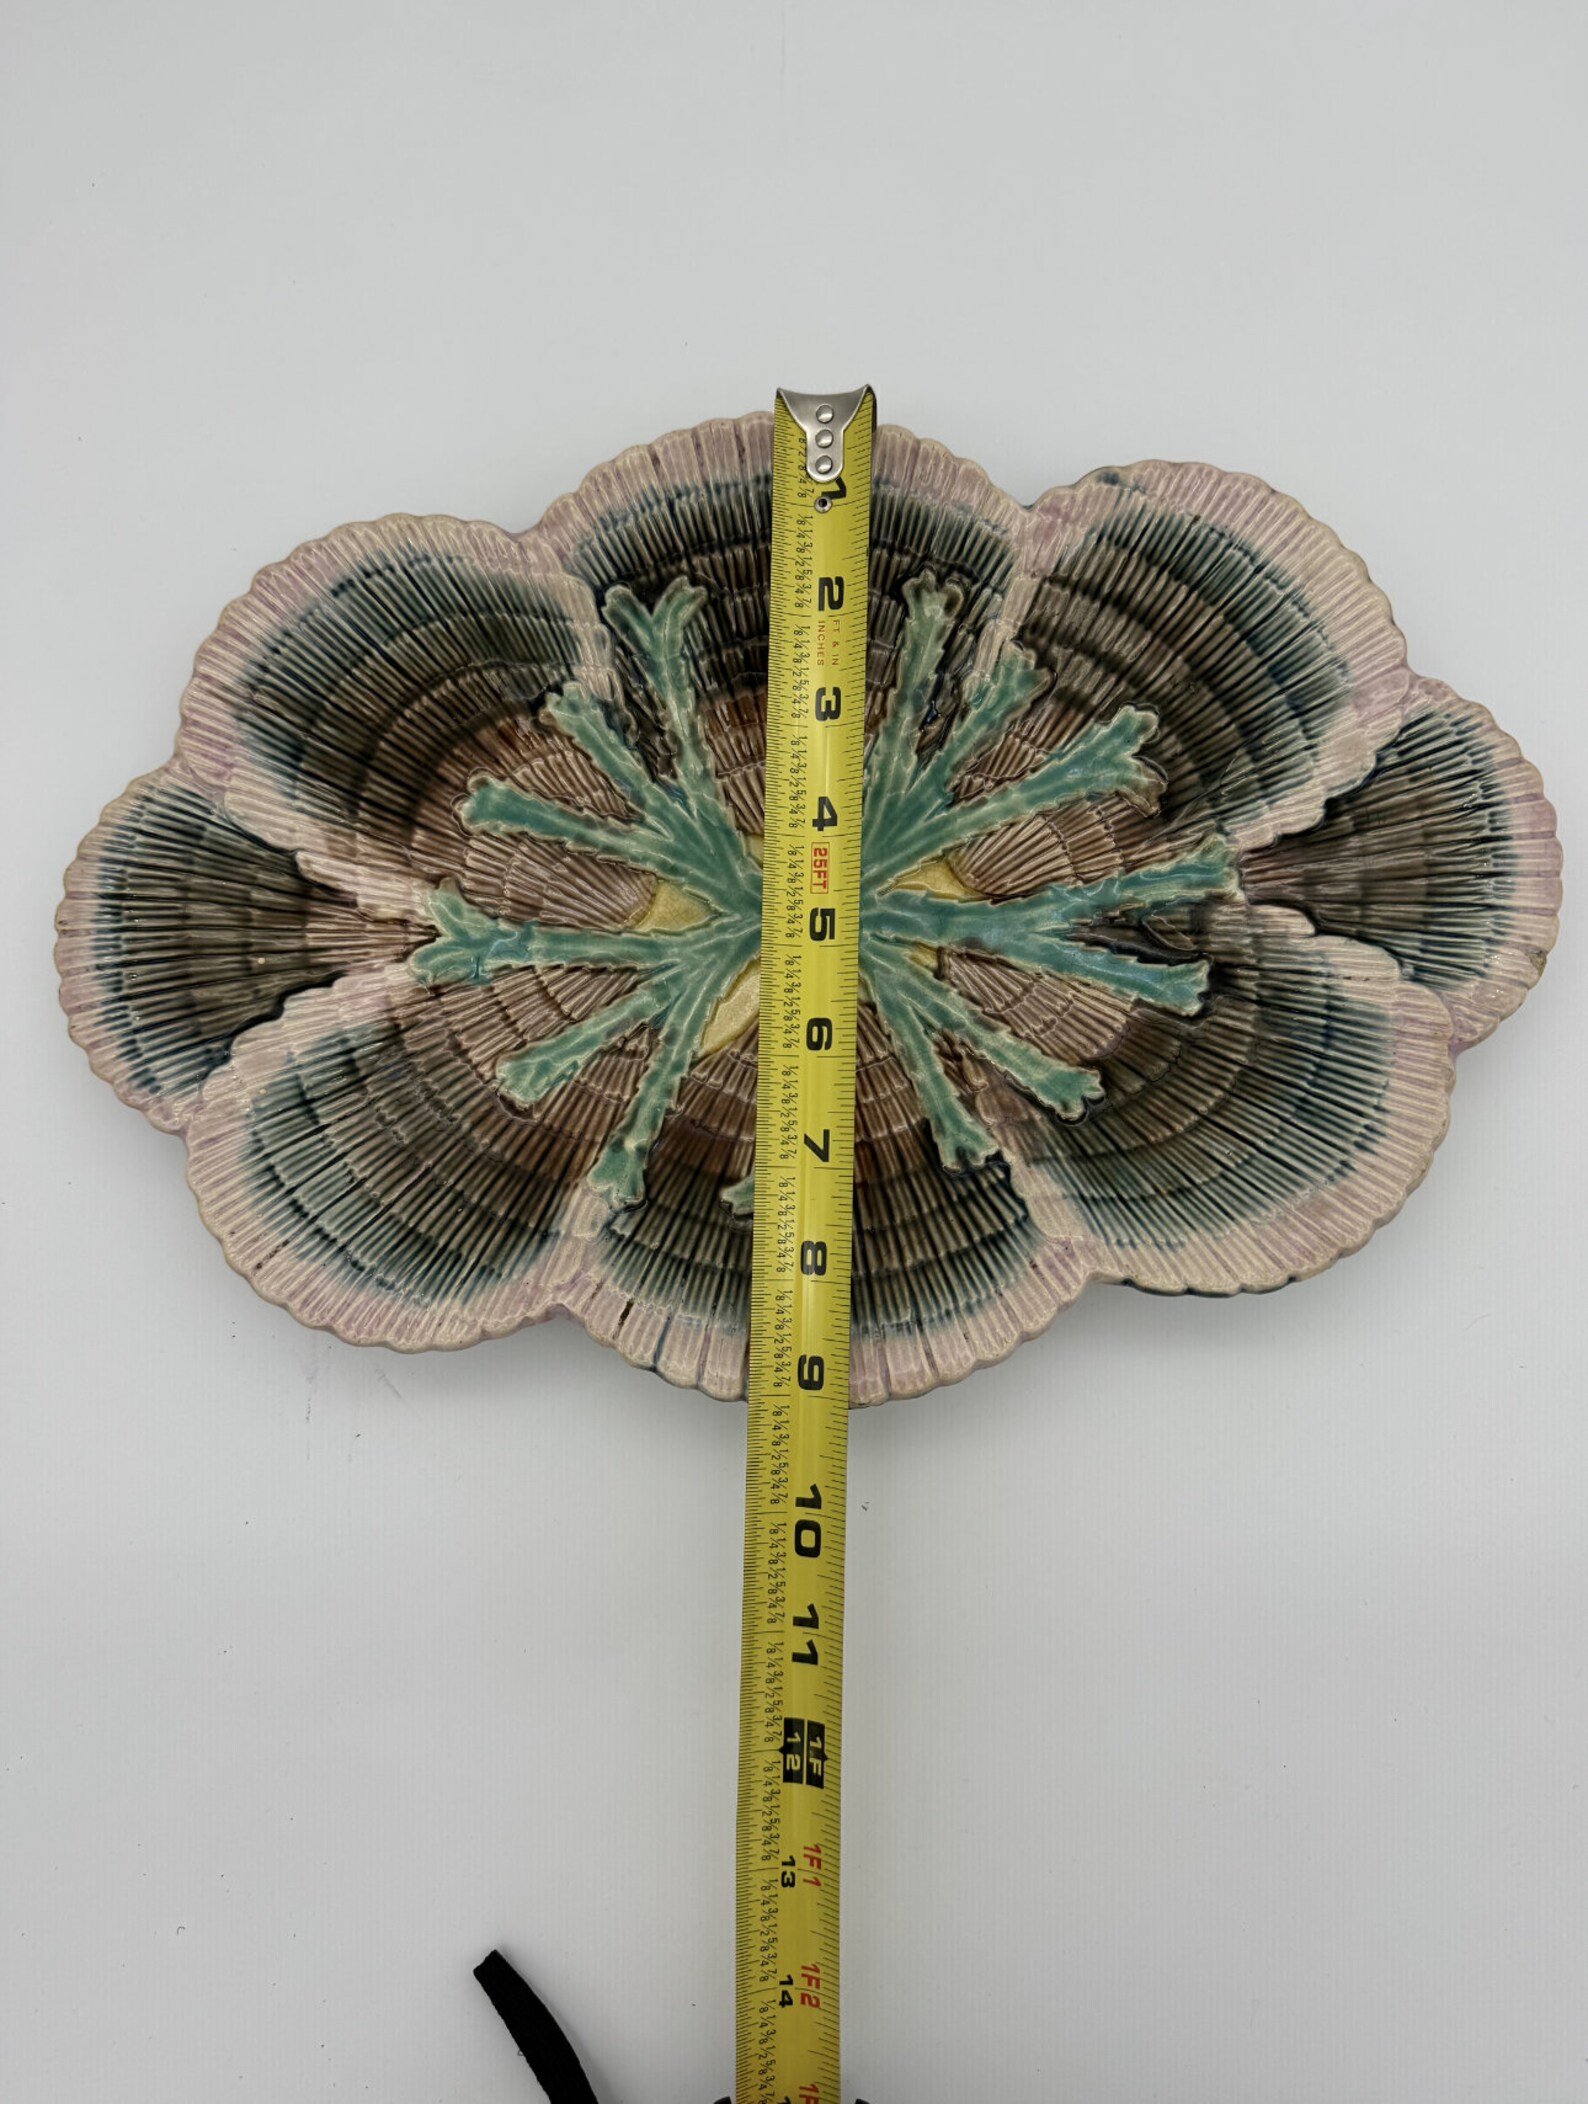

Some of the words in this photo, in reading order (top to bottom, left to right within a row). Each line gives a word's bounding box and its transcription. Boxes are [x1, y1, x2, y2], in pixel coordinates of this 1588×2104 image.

[822, 477, 846, 499] 1
[818, 576, 844, 611] 2
[817, 620, 825, 666] INCHES
[832, 620, 840, 633] FT
[832, 656, 839, 666] IN
[814, 687, 841, 721] 3
[812, 796, 837, 831] 4
[813, 848, 828, 889] 25FT
[809, 908, 835, 941] 5
[806, 1018, 832, 1050] 6
[804, 1129, 830, 1162] 7
[801, 1241, 827, 1276] 8
[798, 1354, 824, 1390] 9
[794, 1484, 822, 1558] 10
[792, 1603, 819, 1665] 11
[786, 1732, 800, 1770] 12
[809, 1737, 822, 1776] 1F
[781, 1855, 795, 1888] 13
[779, 1974, 793, 2008] 14
